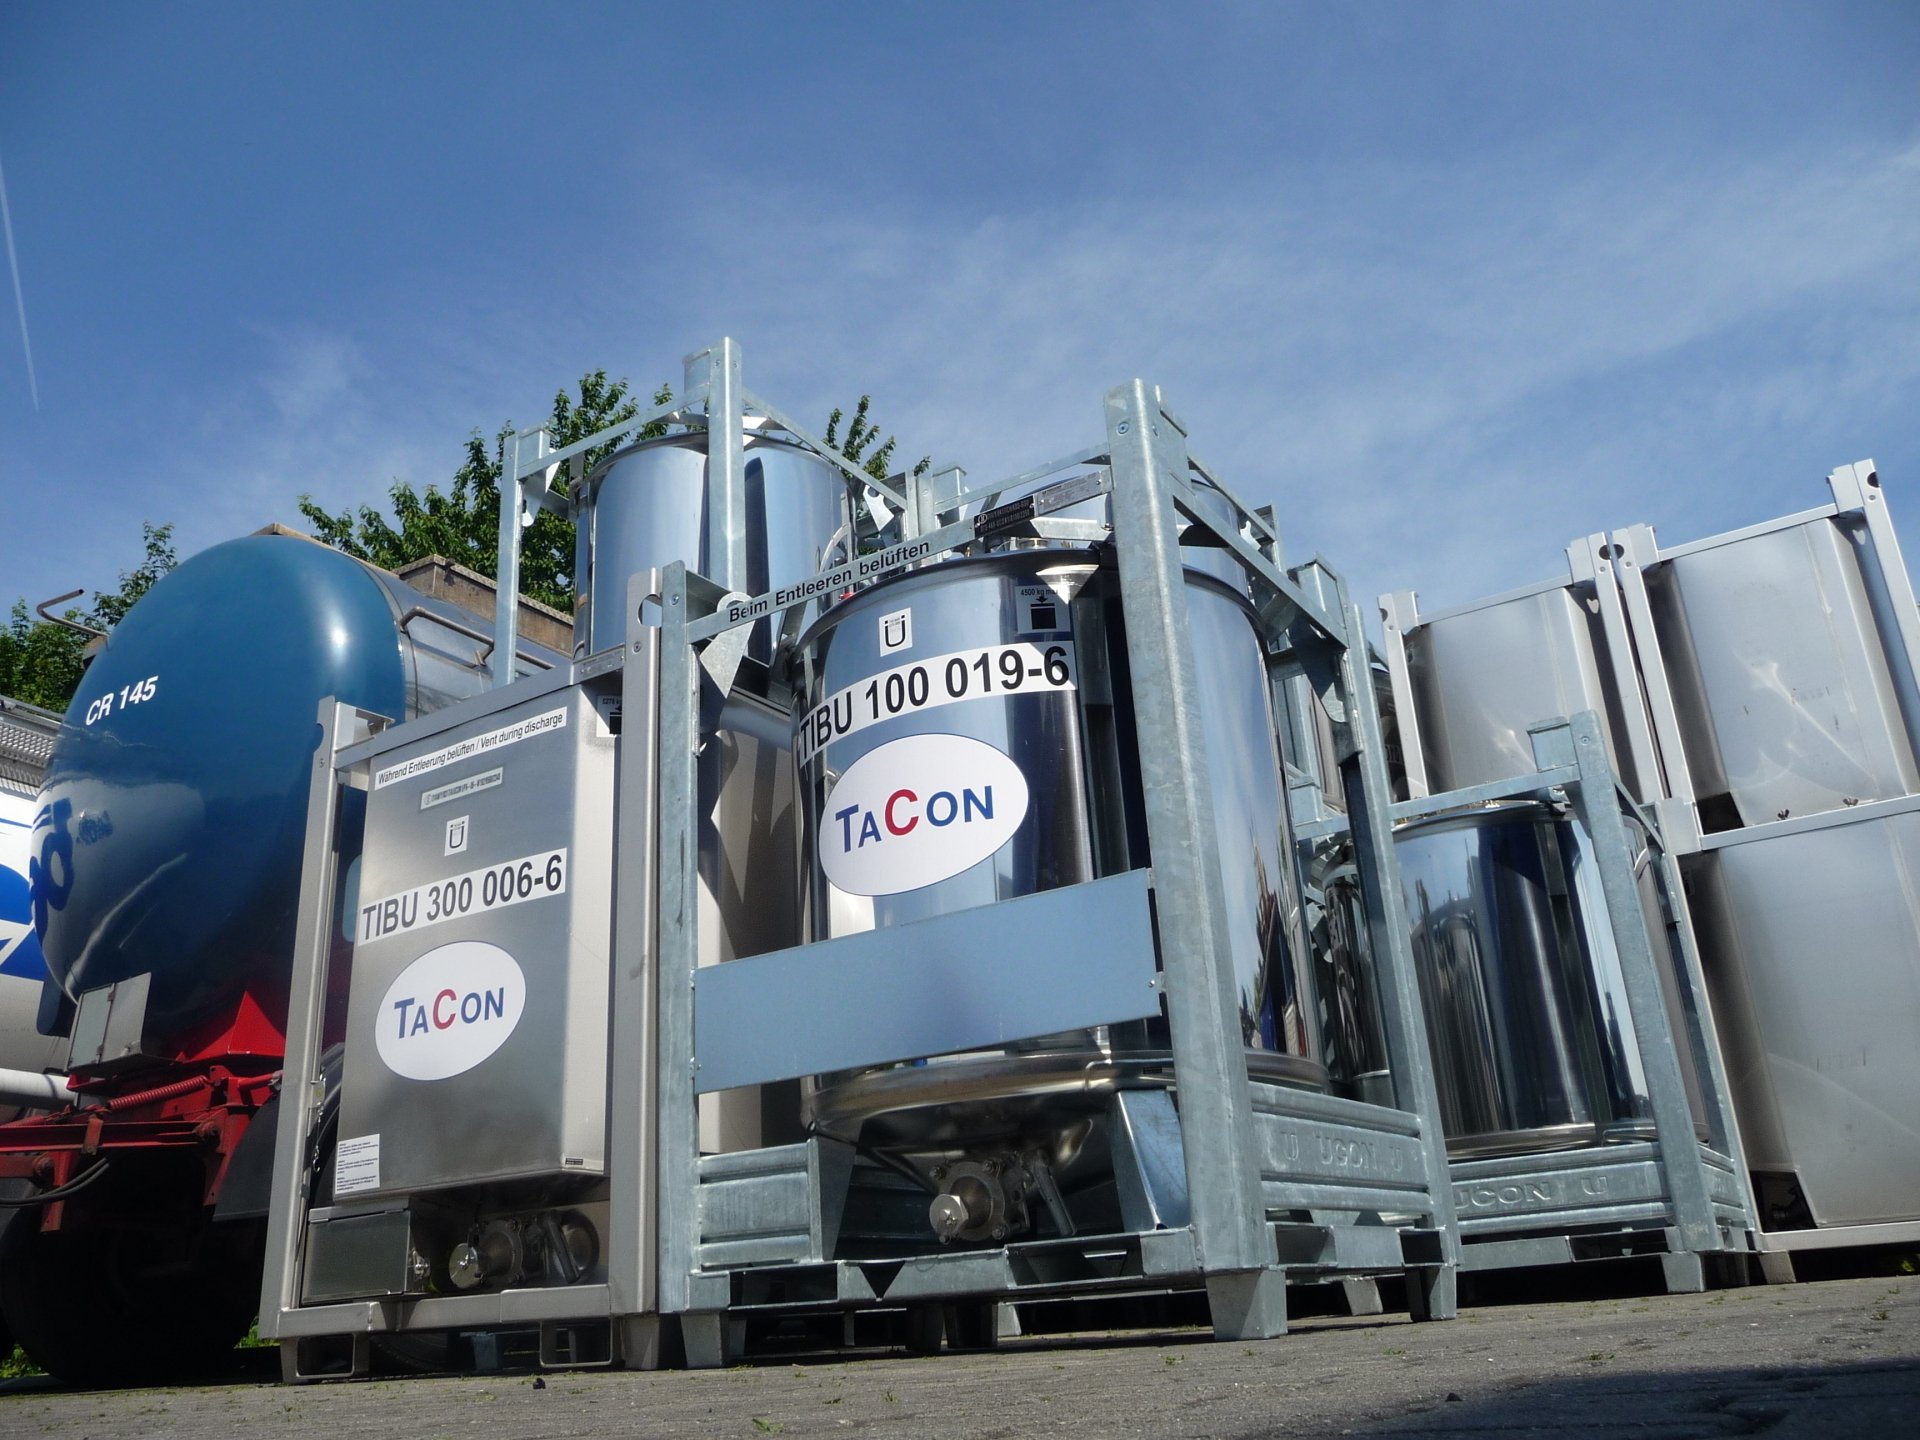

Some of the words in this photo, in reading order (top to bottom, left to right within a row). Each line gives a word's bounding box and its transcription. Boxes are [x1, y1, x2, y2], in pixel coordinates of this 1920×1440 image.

[729, 600, 768, 622] Beim
[775, 570, 852, 606] Entleeren
[859, 541, 930, 575] belüften
[885, 614, 906, 648] Ü
[86, 693, 114, 726] CR
[120, 675, 159, 709] 145
[801, 691, 852, 759] TIBU
[865, 666, 929, 720] 100
[946, 645, 1070, 698] 019-6
[378, 766, 408, 786] Während
[408, 752, 446, 774] Entleerung
[446, 743, 476, 761] belüften
[480, 732, 498, 748] Vent
[498, 724, 523, 744] during
[524, 712, 563, 733] discharge
[449, 821, 466, 849] Ü
[362, 891, 419, 940] TIBU
[426, 877, 473, 921] 300
[482, 854, 562, 907] 006-6
